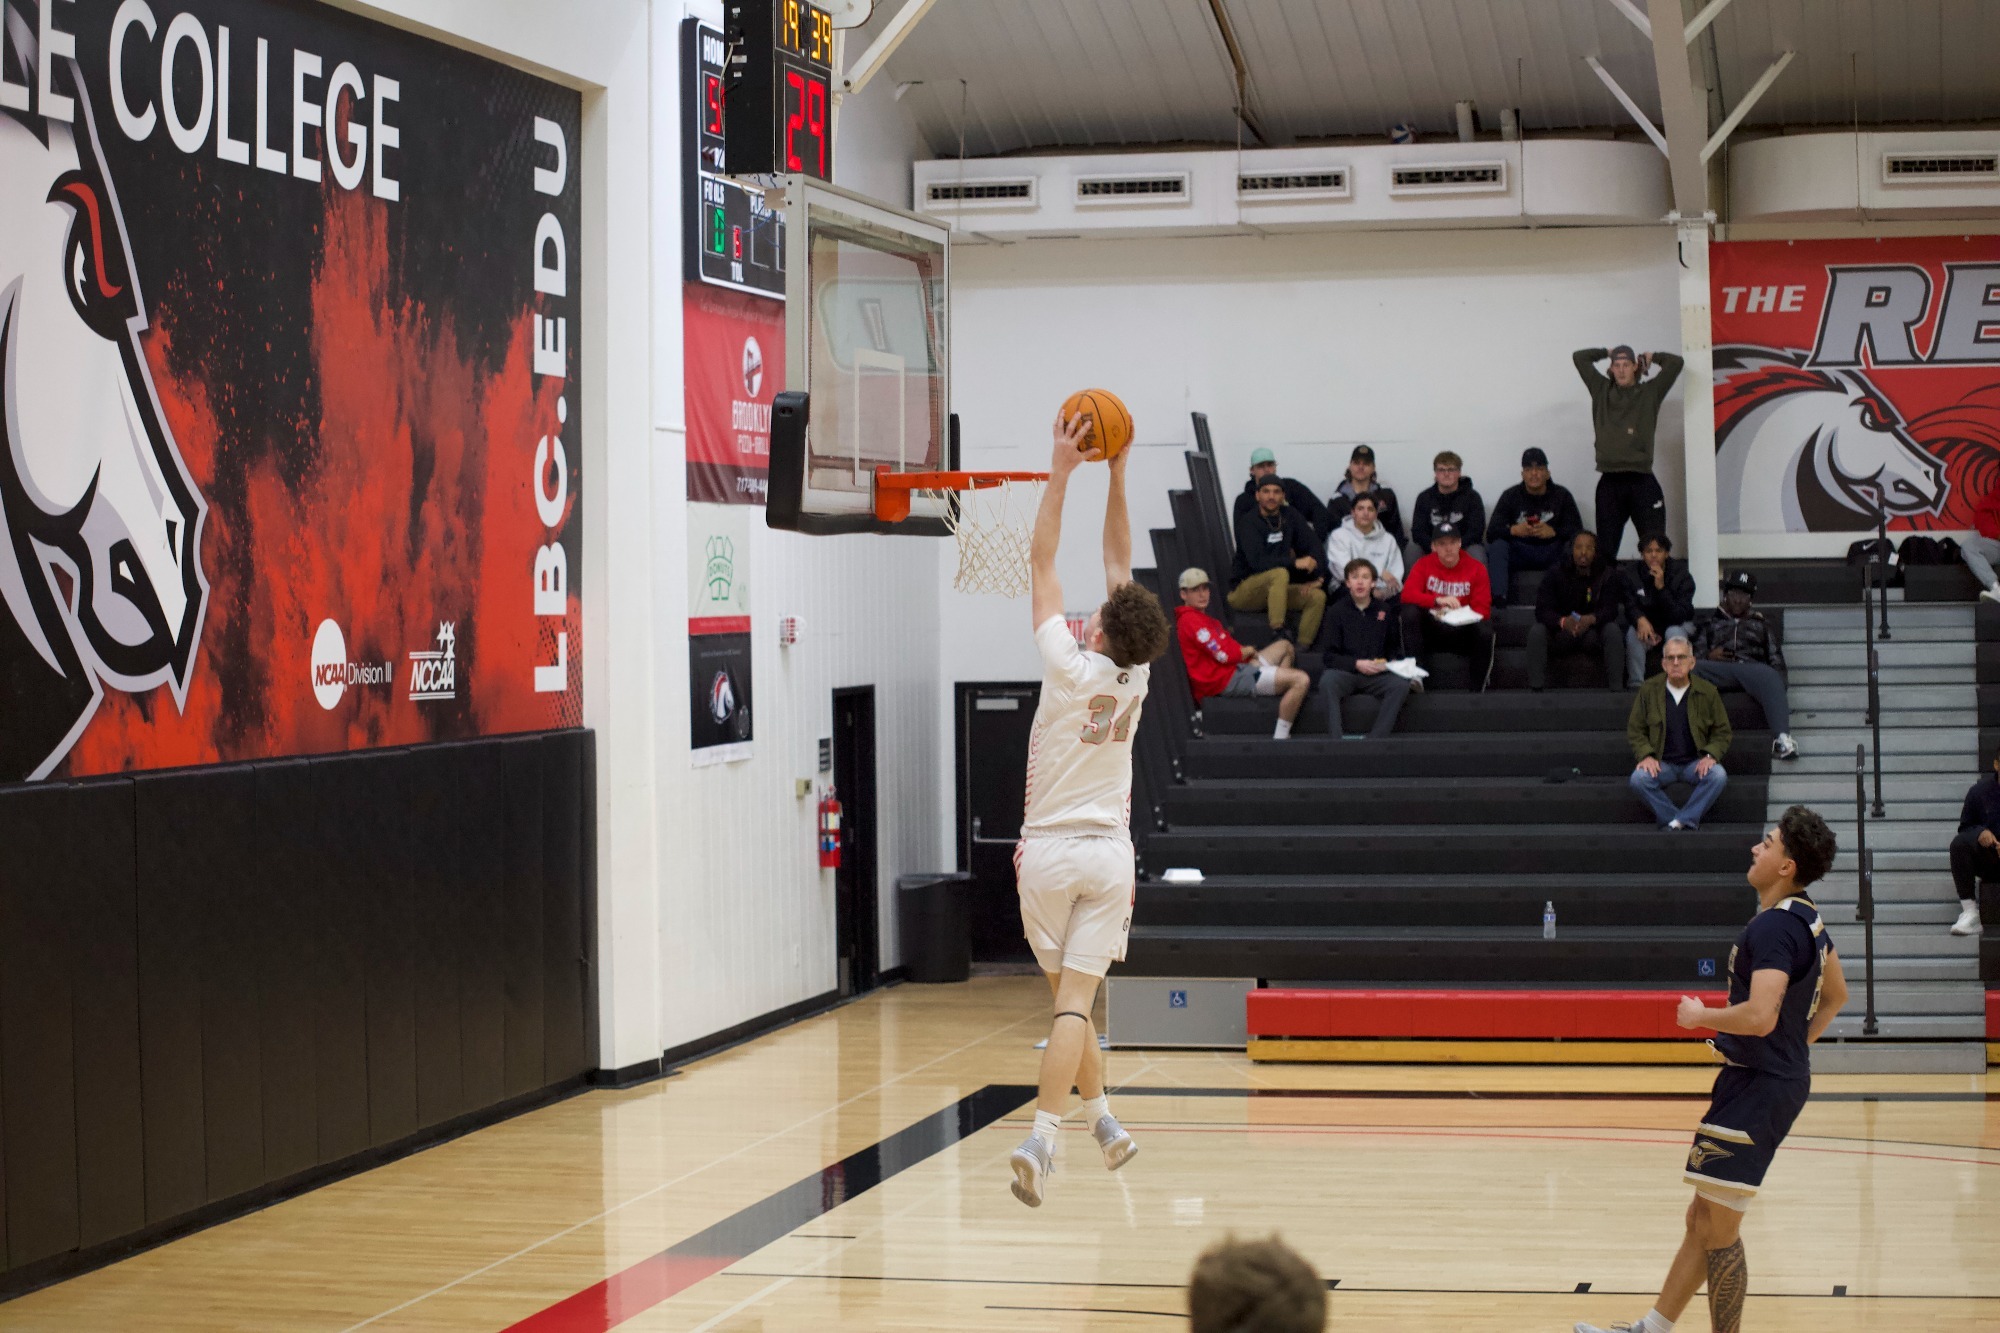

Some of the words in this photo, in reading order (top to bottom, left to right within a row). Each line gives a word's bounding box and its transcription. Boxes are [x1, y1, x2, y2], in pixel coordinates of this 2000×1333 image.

[703, 34, 725, 68] HOM
[109, 0, 400, 202] COLLEGE
[787, 71, 825, 178] 29
[1722, 285, 1806, 313] THE
[534, 116, 567, 692] LBC.EDU
[315, 663, 346, 687] NCAA
[348, 662, 384, 685] Division
[410, 660, 455, 692] NCCAA
